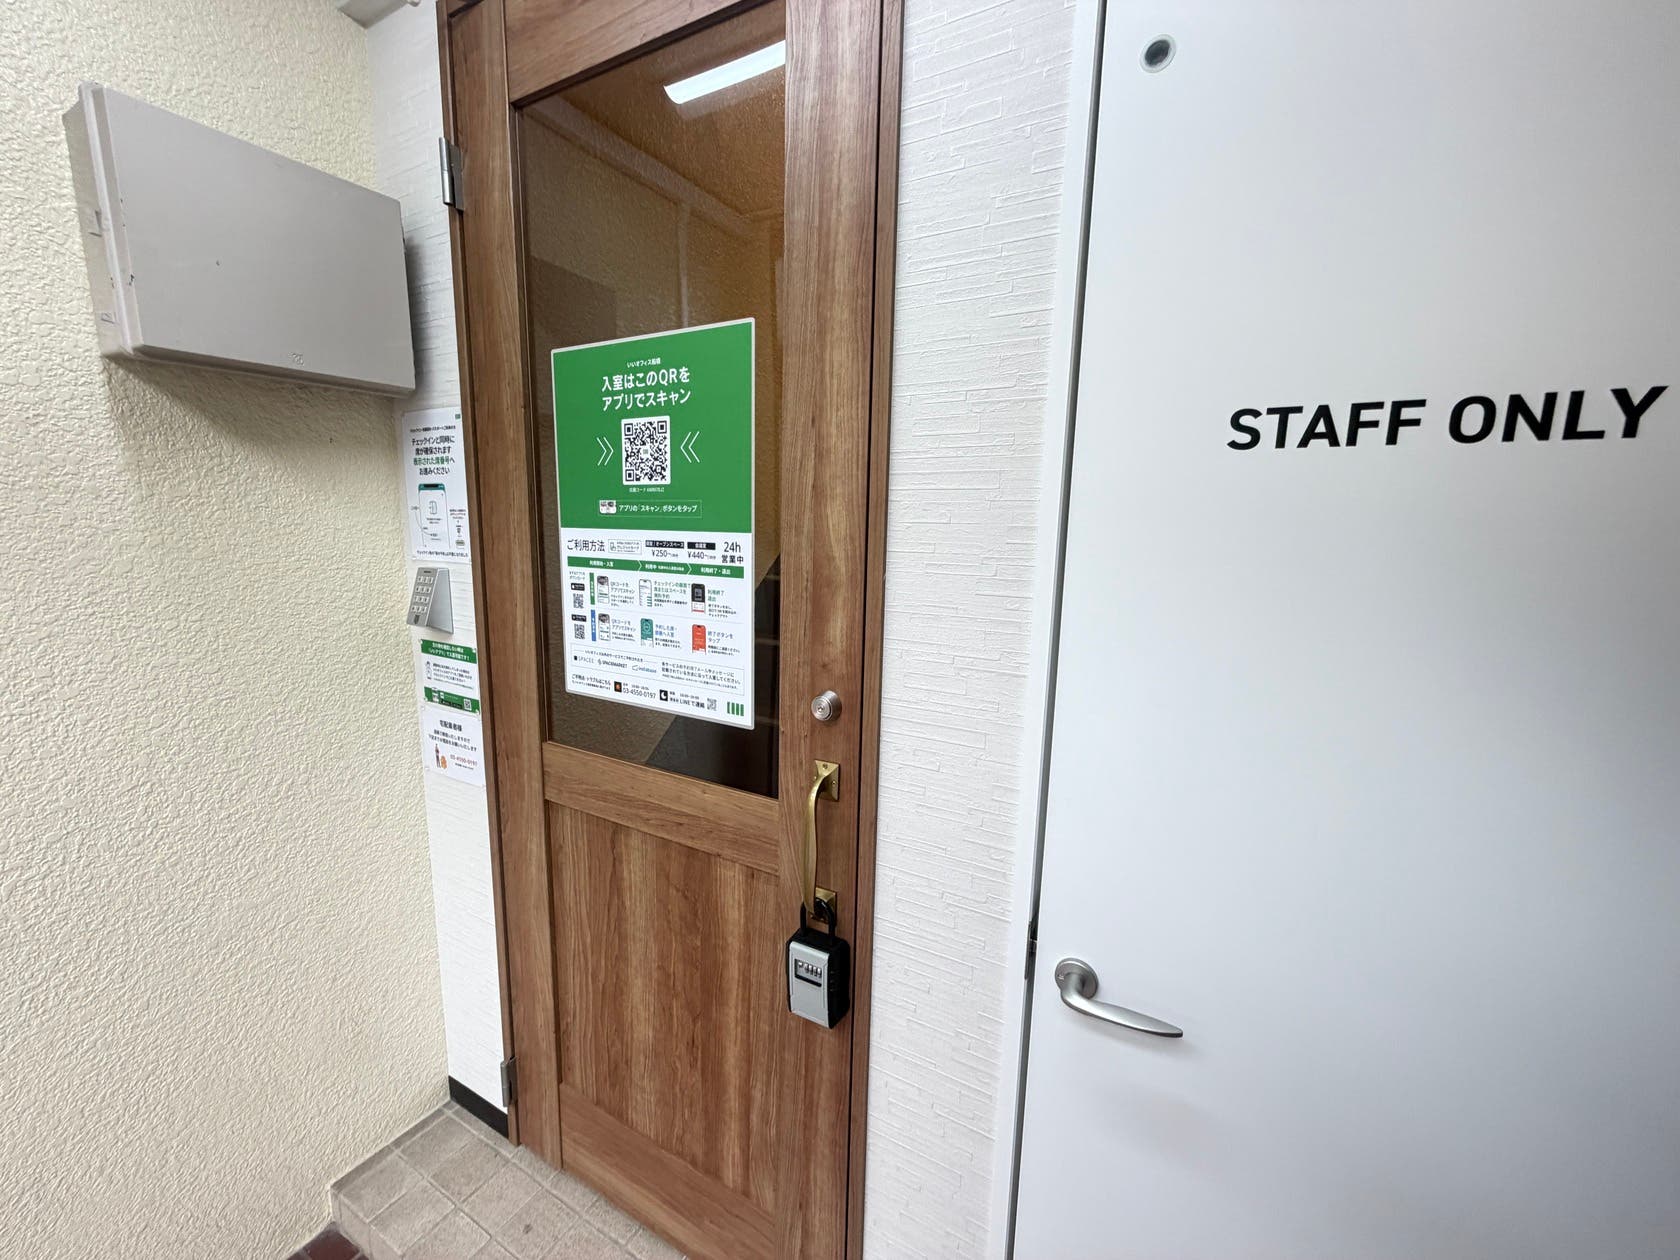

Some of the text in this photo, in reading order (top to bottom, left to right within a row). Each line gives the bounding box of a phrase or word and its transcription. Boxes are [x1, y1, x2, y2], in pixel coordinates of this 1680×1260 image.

[601, 366, 690, 392] 入室はこのQRを
[602, 388, 691, 412] アプリでスキャン
[1226, 385, 1669, 451] STAFF ONLY
[619, 503, 697, 513] アプリの「スキャン」ボタンをタップ
[567, 538, 605, 553] ご利用方法
[723, 541, 741, 553] 24h
[721, 554, 744, 564] 営業中
